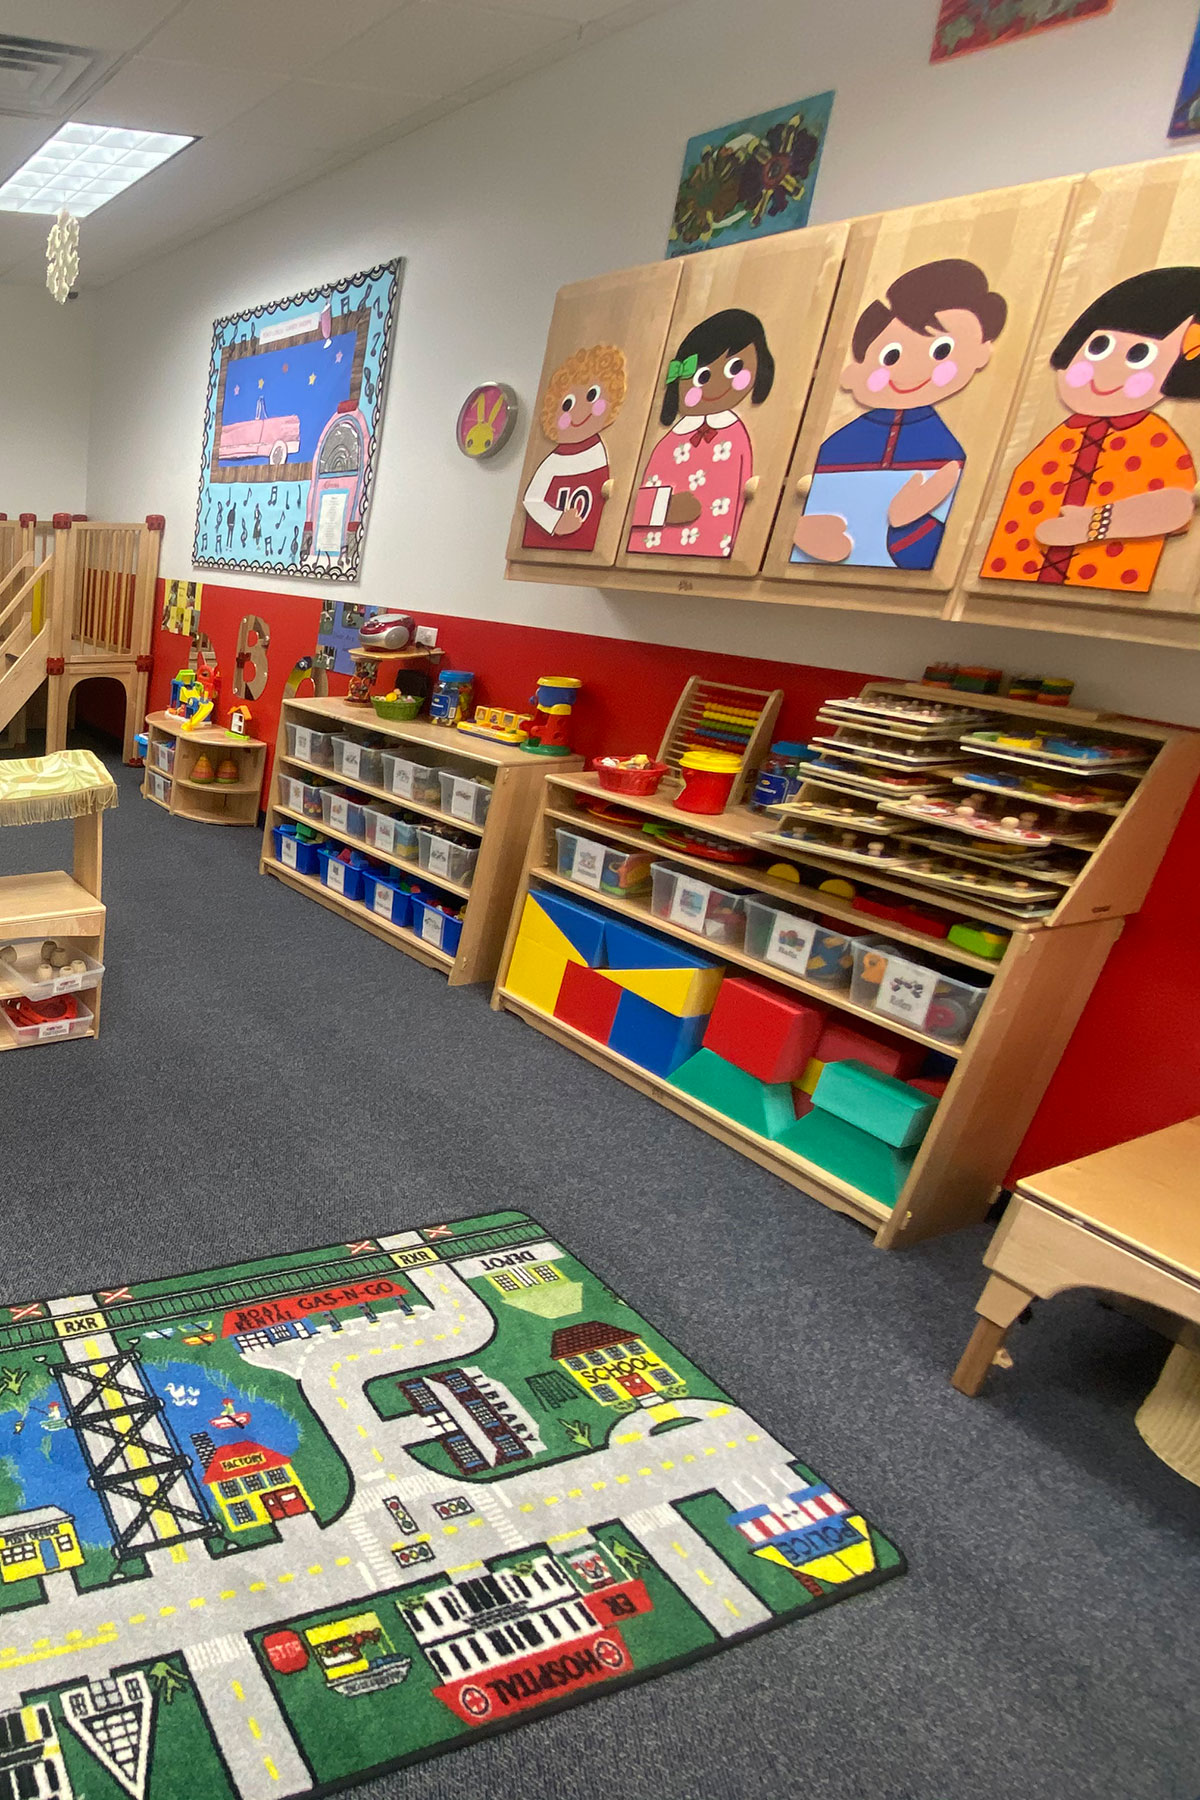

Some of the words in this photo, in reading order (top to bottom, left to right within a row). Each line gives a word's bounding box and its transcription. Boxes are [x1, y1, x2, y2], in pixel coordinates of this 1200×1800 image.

[556, 485, 593, 523] 10
[233, 614, 271, 701] B
[398, 1250, 431, 1265] RXR
[480, 1250, 536, 1271] DEPOT
[297, 1281, 394, 1310] GAS-N-GO
[64, 1317, 99, 1332] RXR
[234, 1310, 296, 1331] RENTAL
[236, 1304, 281, 1321] BOAT
[580, 1355, 660, 1383] SCHOOL
[469, 1374, 538, 1443] LIBRARY
[222, 1452, 263, 1470] FACTORY
[776, 1519, 860, 1562] POLICE
[267, 1639, 301, 1661] STOP
[485, 1648, 603, 1705] HOSPITAL
